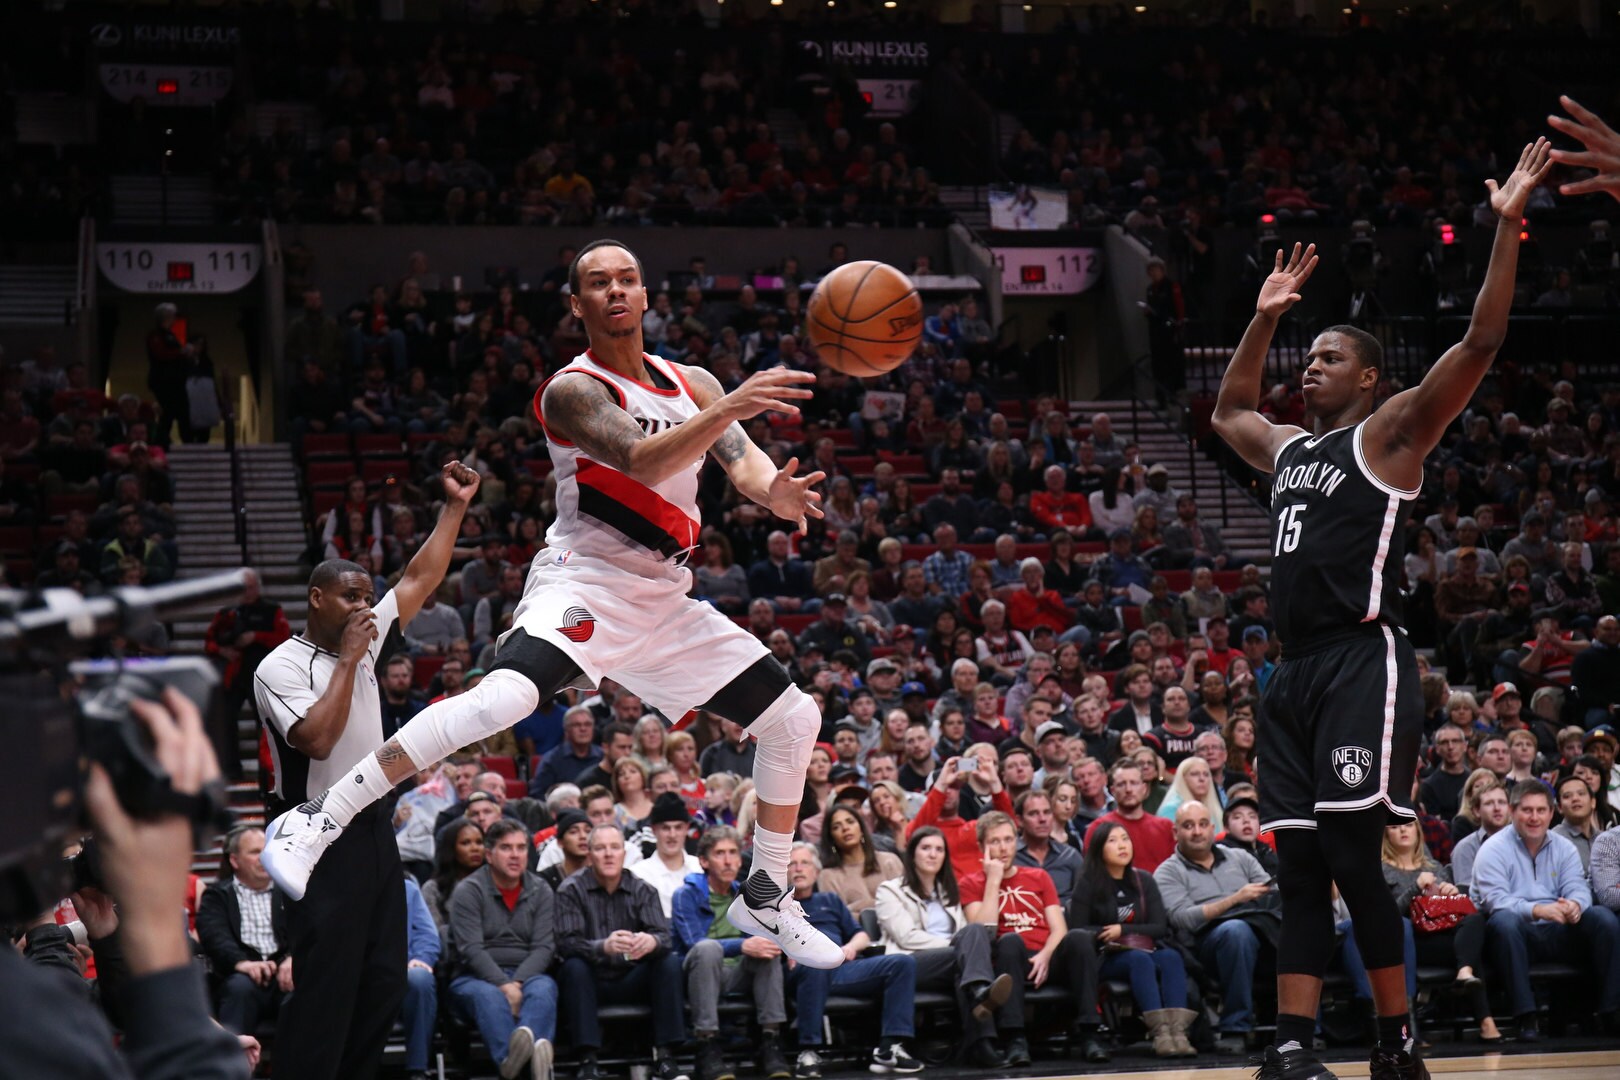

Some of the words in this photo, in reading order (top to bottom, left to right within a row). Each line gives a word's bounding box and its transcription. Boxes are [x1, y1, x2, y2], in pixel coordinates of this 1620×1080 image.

[108, 68, 147, 85] 214
[189, 70, 227, 87] 215
[105, 250, 153, 270] 110
[208, 251, 251, 271] 111
[1056, 254, 1097, 273] 112
[1275, 504, 1308, 557] 15
[1335, 748, 1370, 767] NETS
[1349, 766, 1356, 781] B
